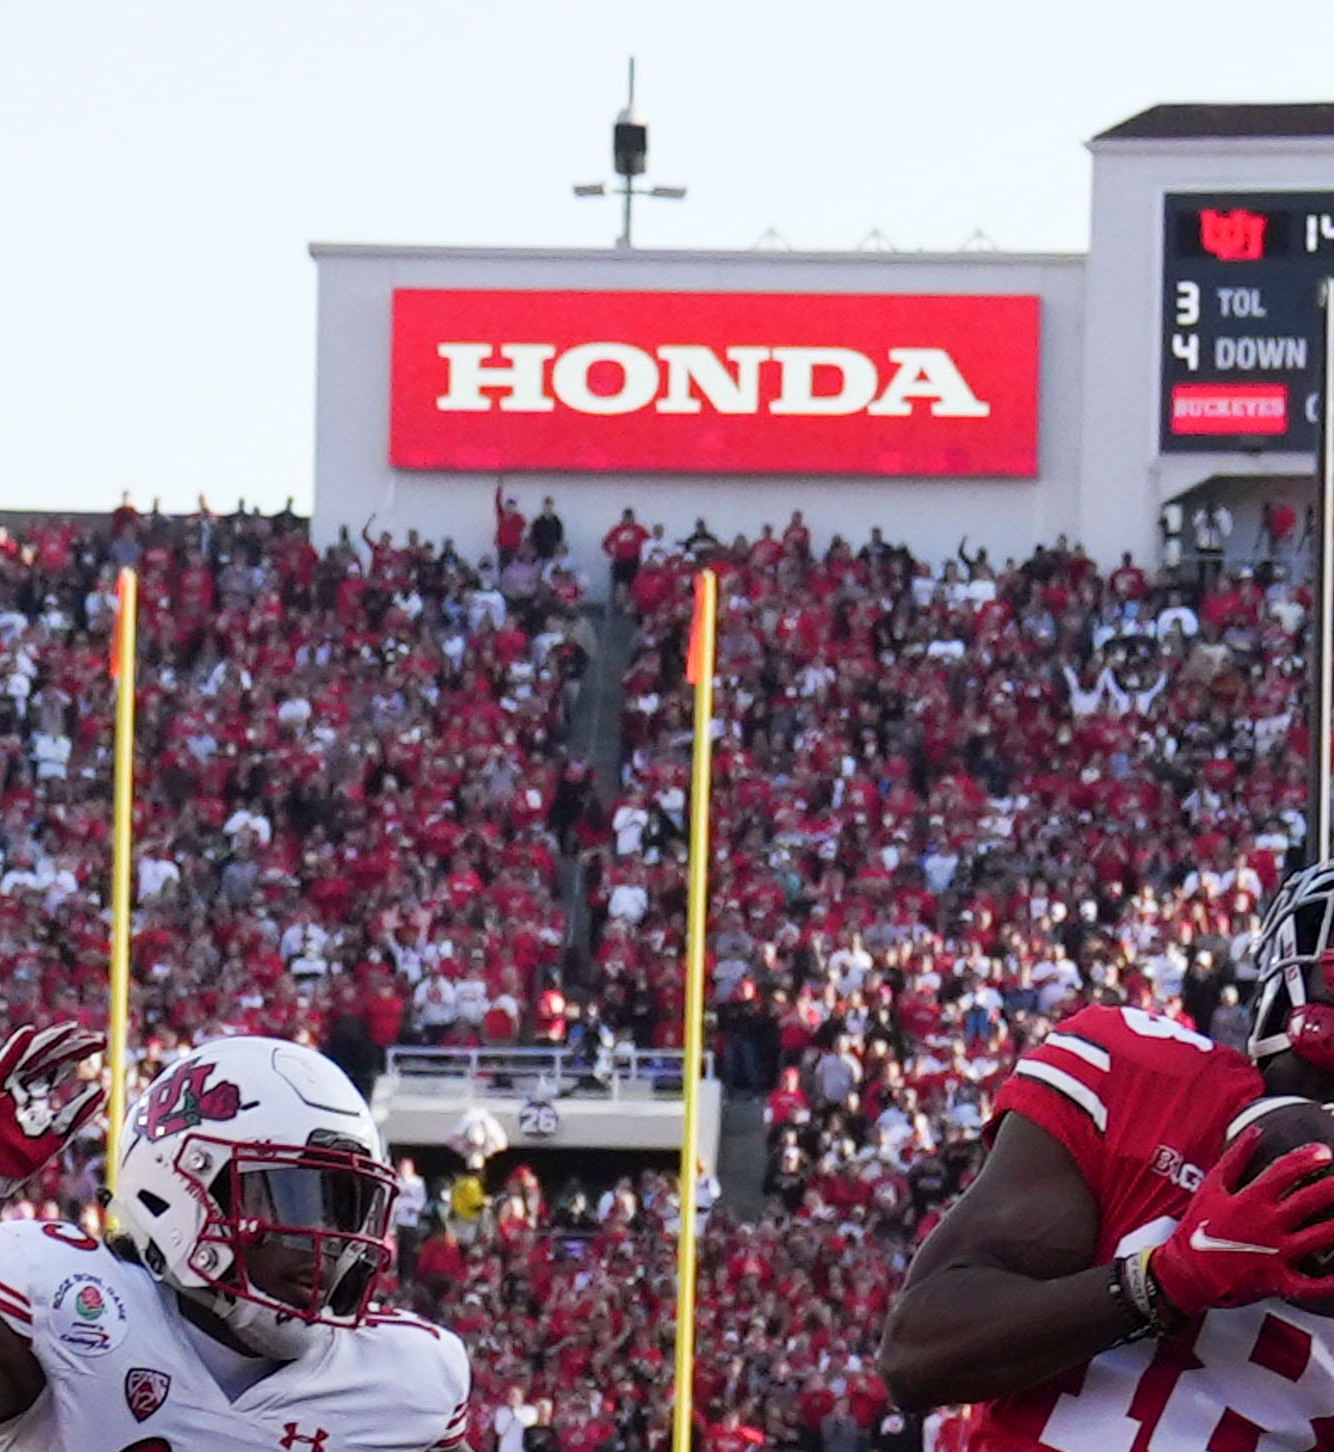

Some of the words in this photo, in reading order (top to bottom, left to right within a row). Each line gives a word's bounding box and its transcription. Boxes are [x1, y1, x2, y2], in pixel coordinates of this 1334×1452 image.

[1176, 281, 1201, 326] 3
[1217, 287, 1267, 318] TOL
[1172, 333, 1200, 371] 4
[1215, 337, 1307, 370] DOWN
[436, 342, 990, 417] HONDA
[1173, 397, 1286, 418] BUCKEYES
[520, 1107, 557, 1134] 26
